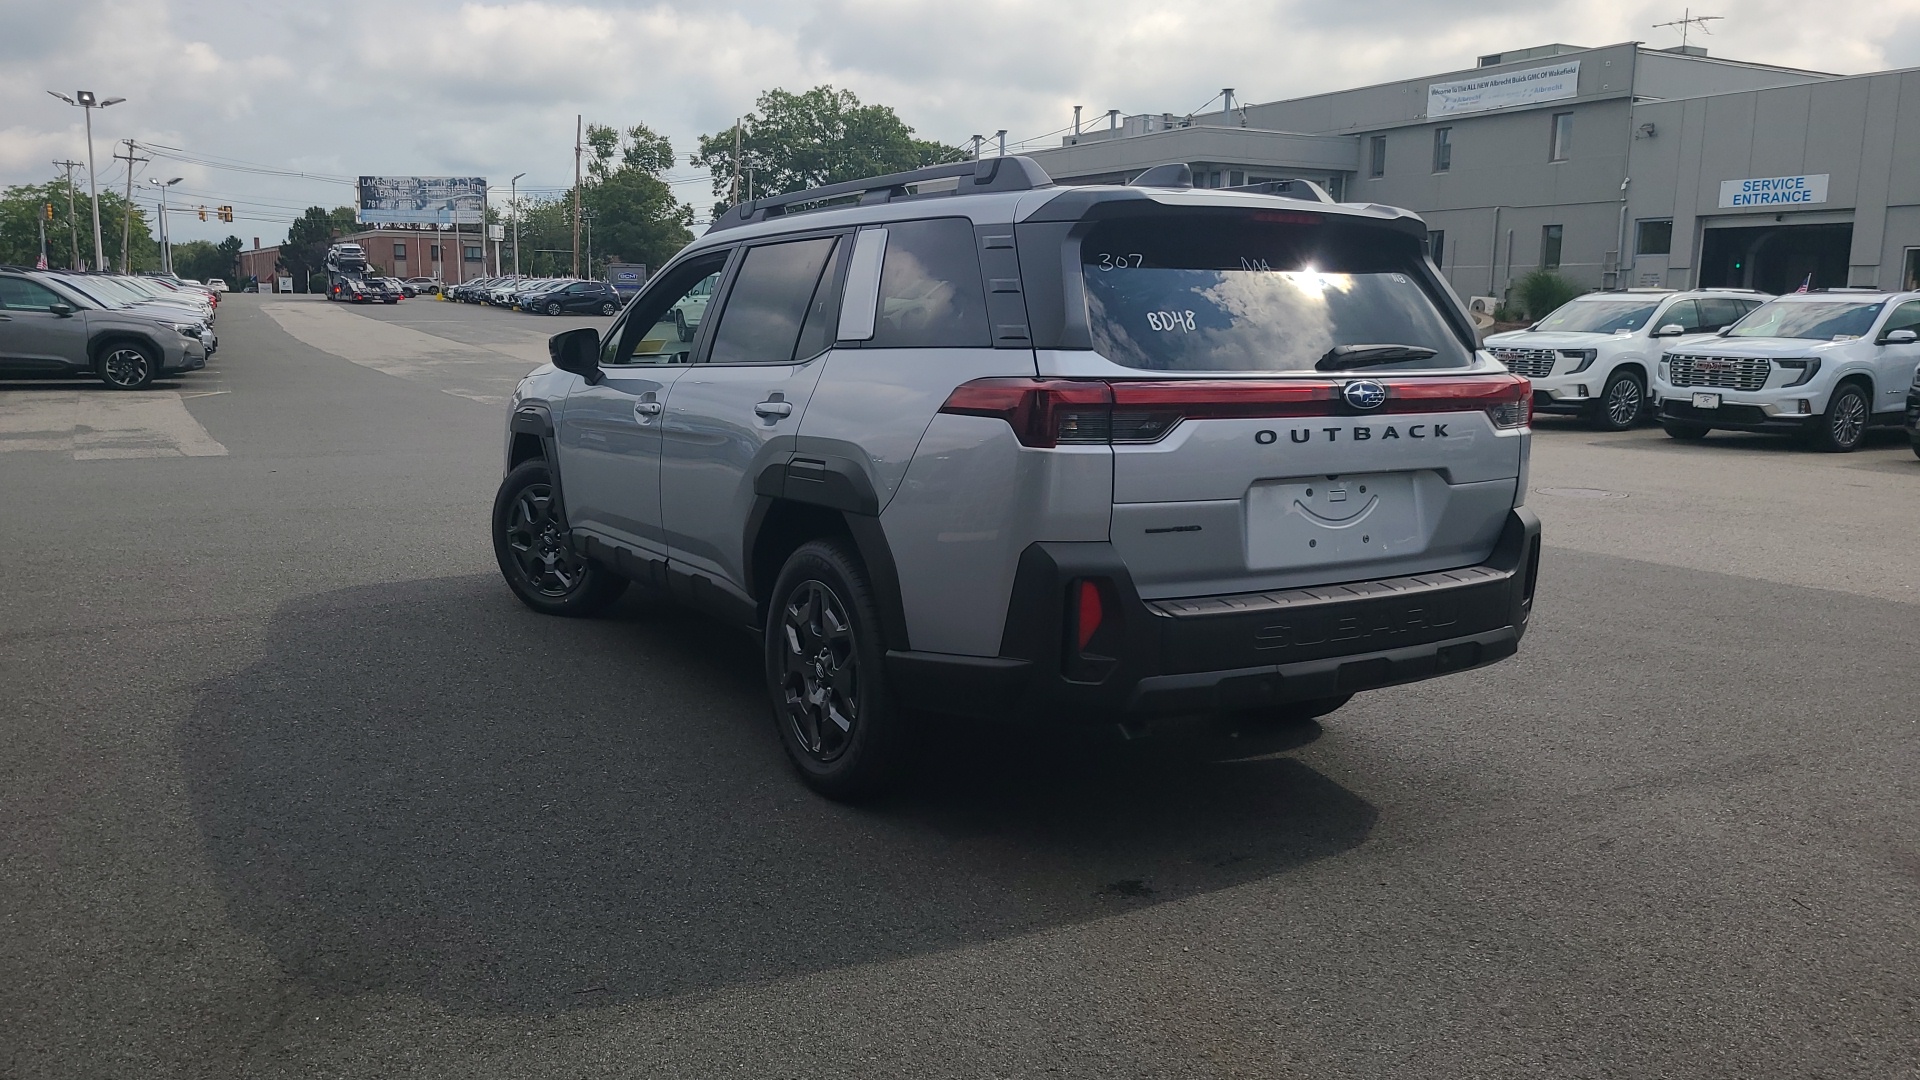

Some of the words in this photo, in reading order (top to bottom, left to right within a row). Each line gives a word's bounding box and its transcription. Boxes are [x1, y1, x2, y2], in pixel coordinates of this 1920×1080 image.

[1466, 83, 1477, 91] ALL
[1476, 81, 1490, 89] NEW
[1489, 77, 1512, 87] Albrecht
[1511, 76, 1527, 84] Buick
[1527, 73, 1541, 81] GMC
[1540, 71, 1548, 79] Of
[1548, 66, 1576, 77] Wakefield
[362, 178, 398, 187] LAKESIDE
[1742, 178, 1805, 192] SERVICE
[374, 189, 409, 198] LEASING
[1733, 190, 1812, 205] ENTRANCE
[1098, 253, 1144, 272] 307
[1146, 310, 1197, 334] BD48
[1255, 423, 1450, 445] OUTBACK
